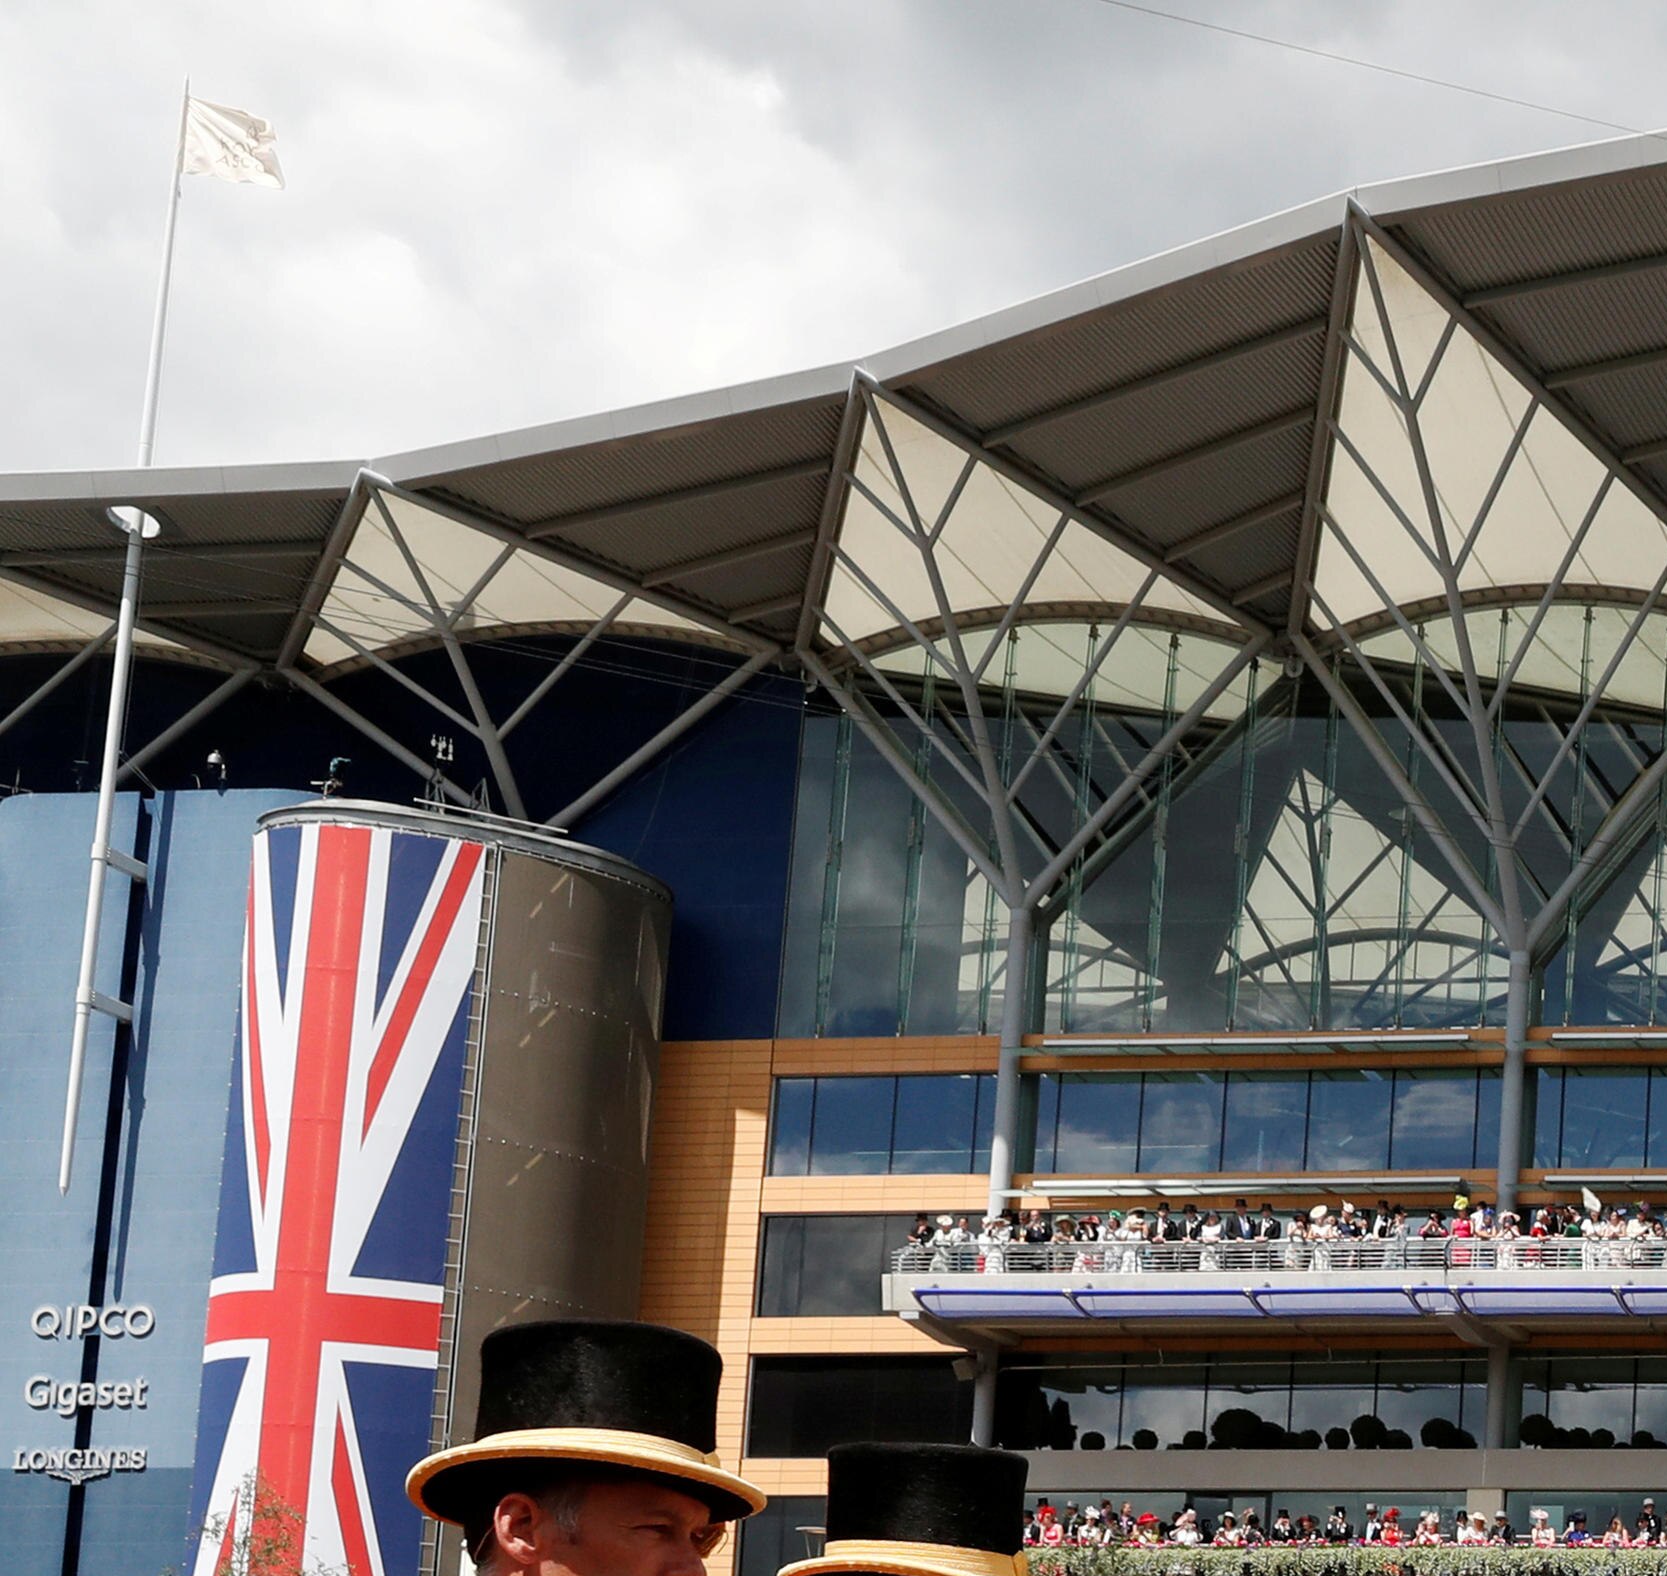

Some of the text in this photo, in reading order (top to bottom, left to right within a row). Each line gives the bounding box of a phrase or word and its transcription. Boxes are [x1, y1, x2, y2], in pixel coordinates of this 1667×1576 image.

[31, 1305, 155, 1339] QIPCO
[24, 1376, 149, 1416] Gigaset
[11, 1450, 147, 1471] LONGINES
